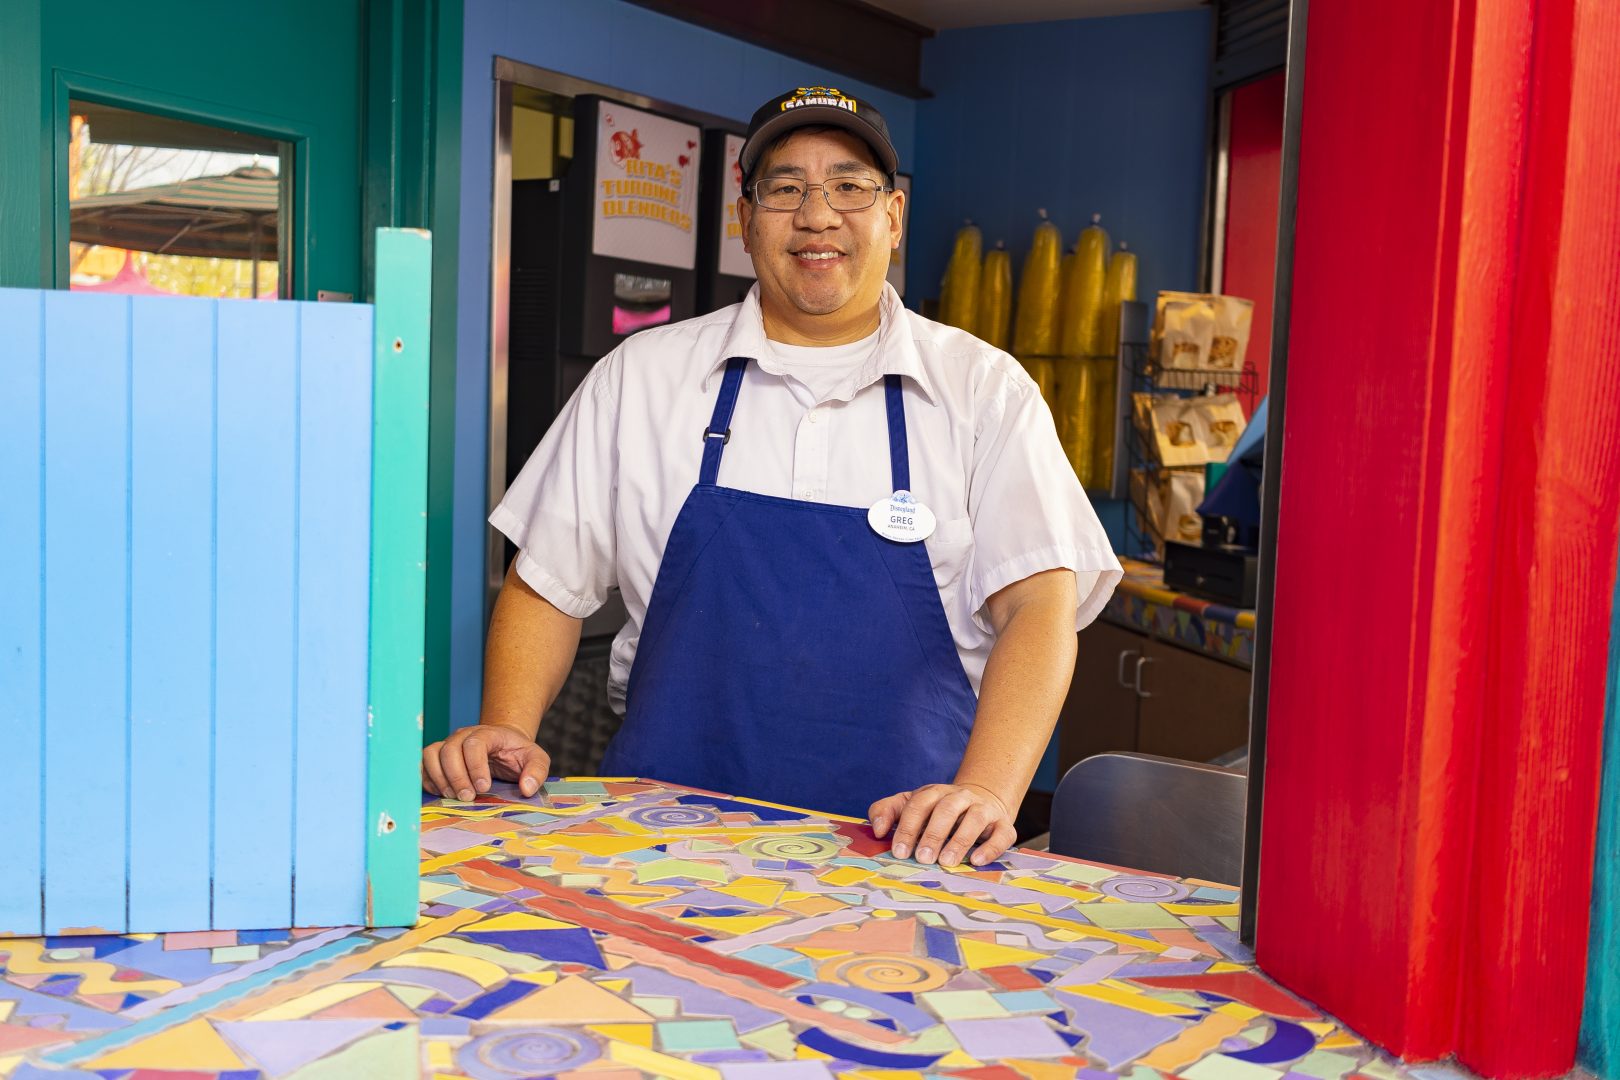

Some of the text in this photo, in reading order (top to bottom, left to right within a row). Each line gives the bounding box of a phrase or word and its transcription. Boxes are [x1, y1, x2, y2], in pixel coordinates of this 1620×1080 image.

[785, 97, 853, 112] SAMURAI
[626, 159, 683, 187] RITA'S
[601, 180, 680, 205] TURBINE
[602, 201, 693, 232] BLENDERS
[890, 515, 913, 525] GREG
